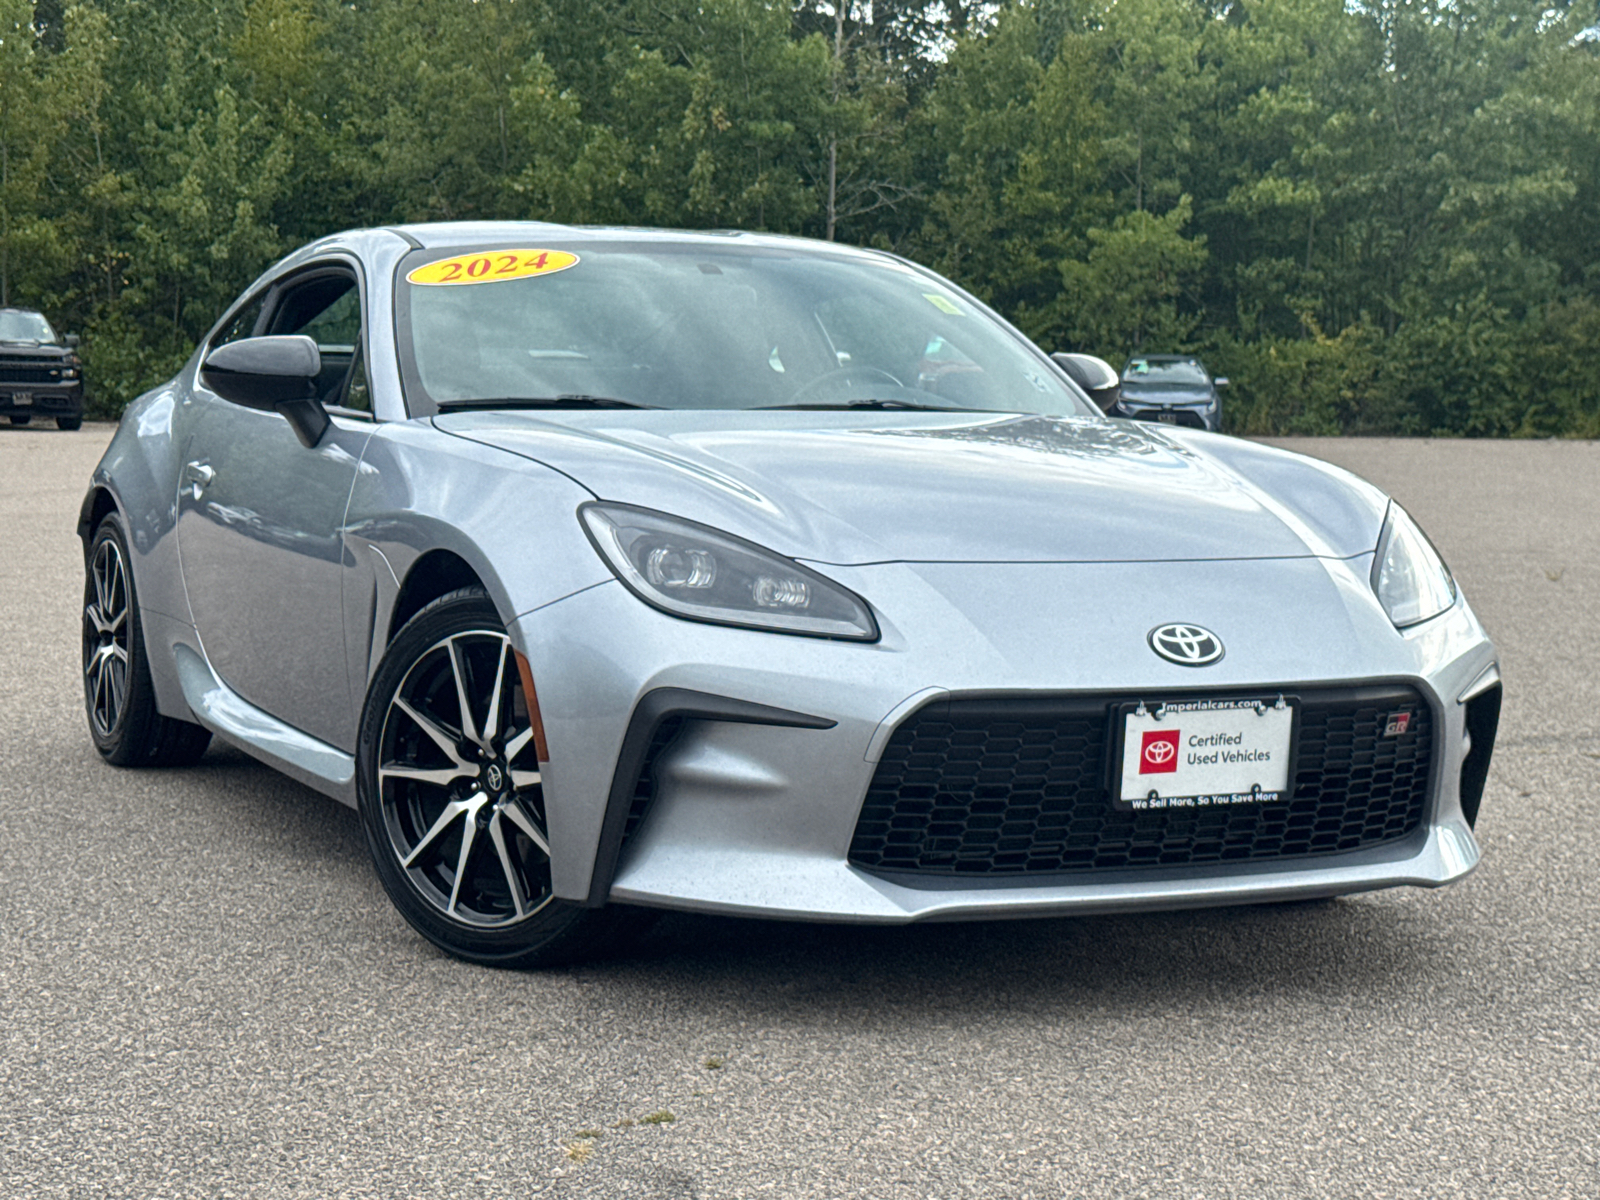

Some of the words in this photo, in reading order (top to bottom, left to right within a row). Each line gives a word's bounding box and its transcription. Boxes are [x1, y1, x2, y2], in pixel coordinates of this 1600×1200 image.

[438, 252, 549, 282] 2024
[1161, 700, 1262, 713] Imperialcars.com
[1188, 732, 1243, 748] Certified
[1187, 752, 1219, 765] Used
[1221, 749, 1271, 764] Vehicles
[1132, 799, 1148, 810] We
[1149, 798, 1167, 809] Sell
[1169, 797, 1195, 808] More,
[1197, 795, 1210, 806] So
[1211, 794, 1230, 805] You
[1231, 793, 1254, 804] Save
[1255, 792, 1279, 802] More
